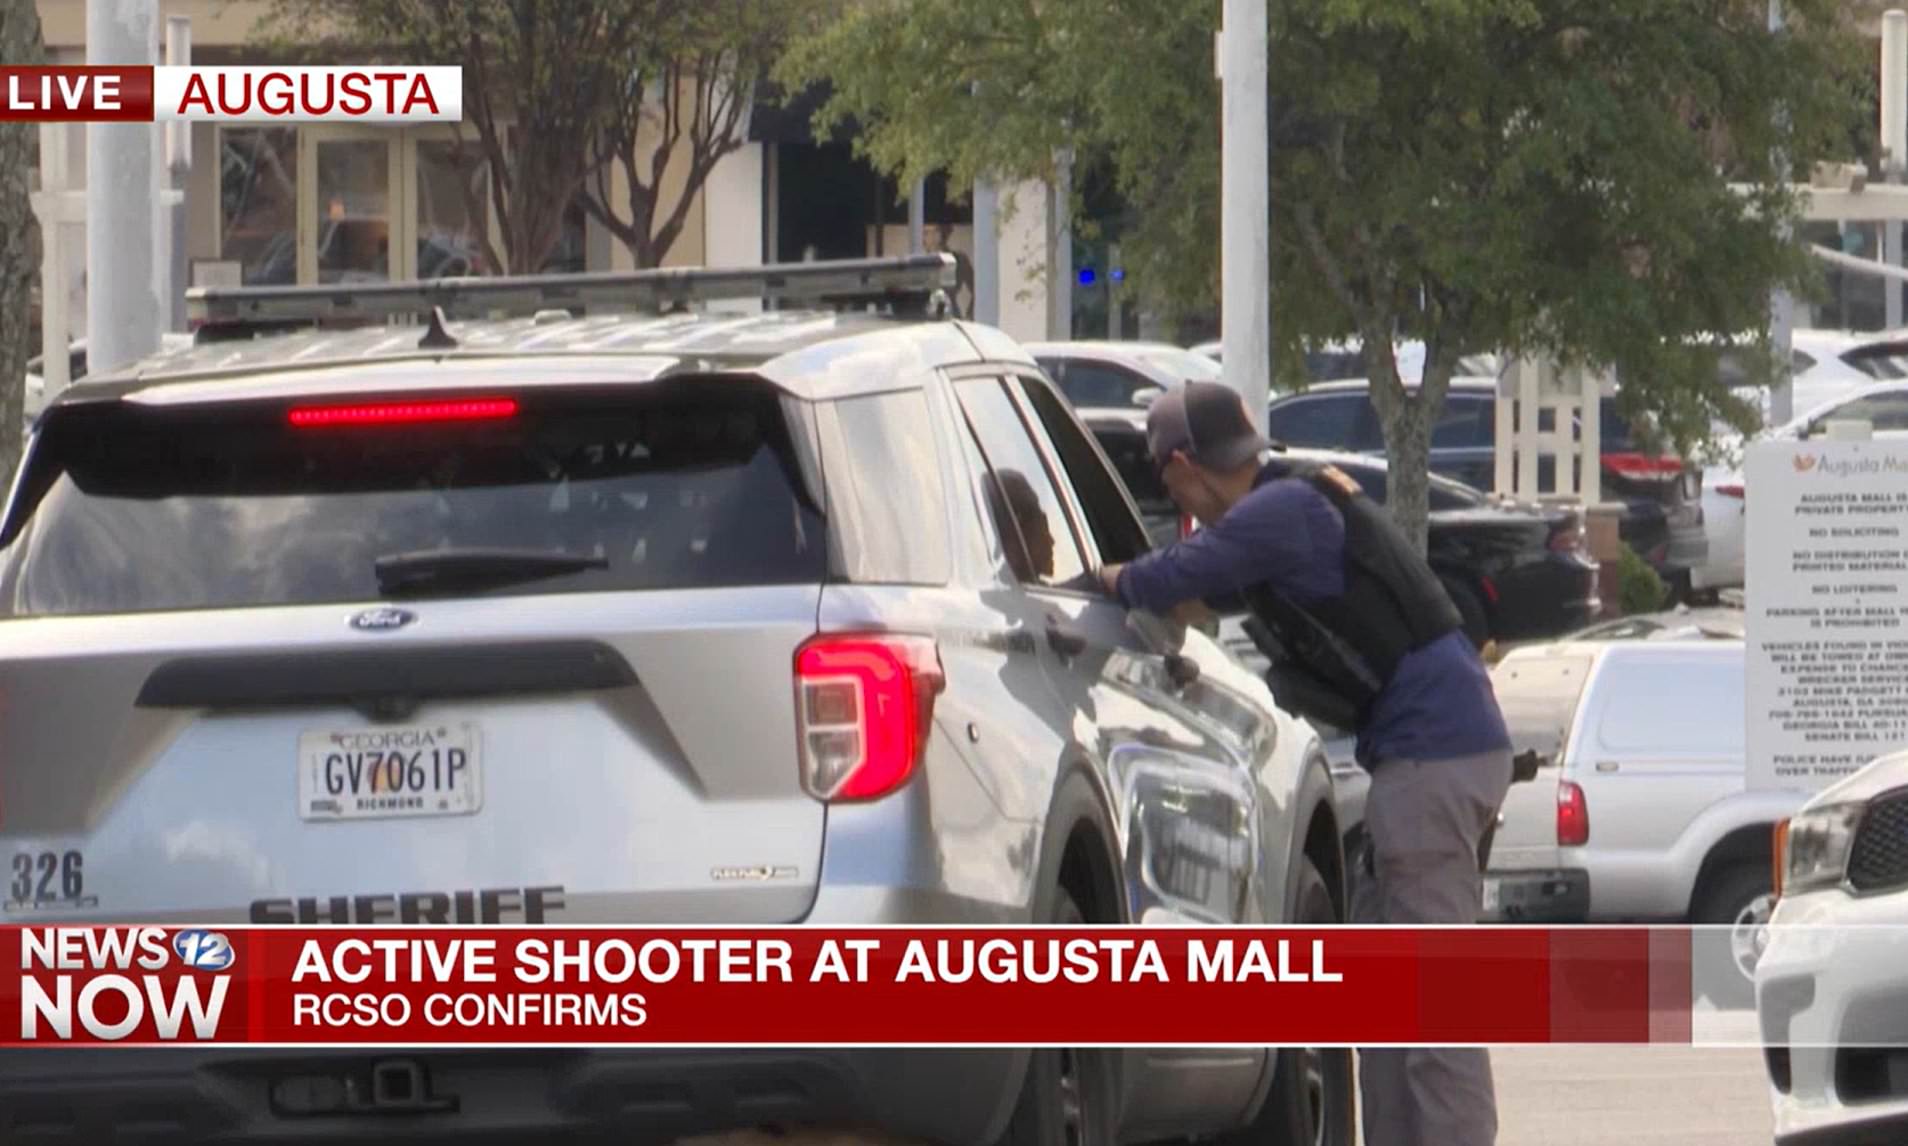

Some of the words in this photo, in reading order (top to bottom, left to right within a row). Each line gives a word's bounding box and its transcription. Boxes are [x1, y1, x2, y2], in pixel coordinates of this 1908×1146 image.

[1817, 453, 1880, 477] Augusta
[1800, 493, 1858, 503] AUGUSTA
[1861, 493, 1892, 503] MALL
[1794, 504, 1844, 515] PRIVATE
[1809, 527, 1828, 538] NO
[1831, 527, 1900, 538] SOLICITING
[1793, 550, 1811, 561] NO
[1814, 550, 1900, 561] DISTRIBUTION
[1792, 562, 1845, 572] PRINTED
[1812, 584, 1830, 595] NO
[1833, 584, 1898, 595] LOITERING
[1766, 607, 1820, 618] PARKING
[1824, 607, 1861, 618] AFTER
[1865, 607, 1895, 618] MALL
[1810, 618, 1822, 629] IS
[1825, 618, 1900, 629] PROHIBITED
[1761, 641, 1820, 652] VEHICLES
[1823, 641, 1867, 652] FOUND
[1870, 641, 1883, 652] IN
[1771, 653, 1796, 663] WILL
[1801, 653, 1817, 663] BE
[1821, 653, 1863, 663] TOWED
[1867, 653, 1880, 663] AT
[1781, 664, 1837, 675] EXPENSE
[1842, 664, 1857, 675] TO
[1797, 675, 1857, 685] WRECKER
[1813, 687, 1842, 697] MIKE
[1857, 698, 1873, 708] GA
[1782, 720, 1839, 731] GEORGIA
[338, 729, 434, 750] GEORGIA
[1805, 732, 1850, 742] SENATE
[1773, 754, 1816, 765] POLICE
[1820, 754, 1852, 765] HAVE
[325, 747, 467, 796] GV7061P
[1775, 766, 1809, 777] OVER
[356, 797, 424, 810] RICHMOND
[12, 851, 83, 903] 326
[250, 886, 566, 924] SHERIFF
